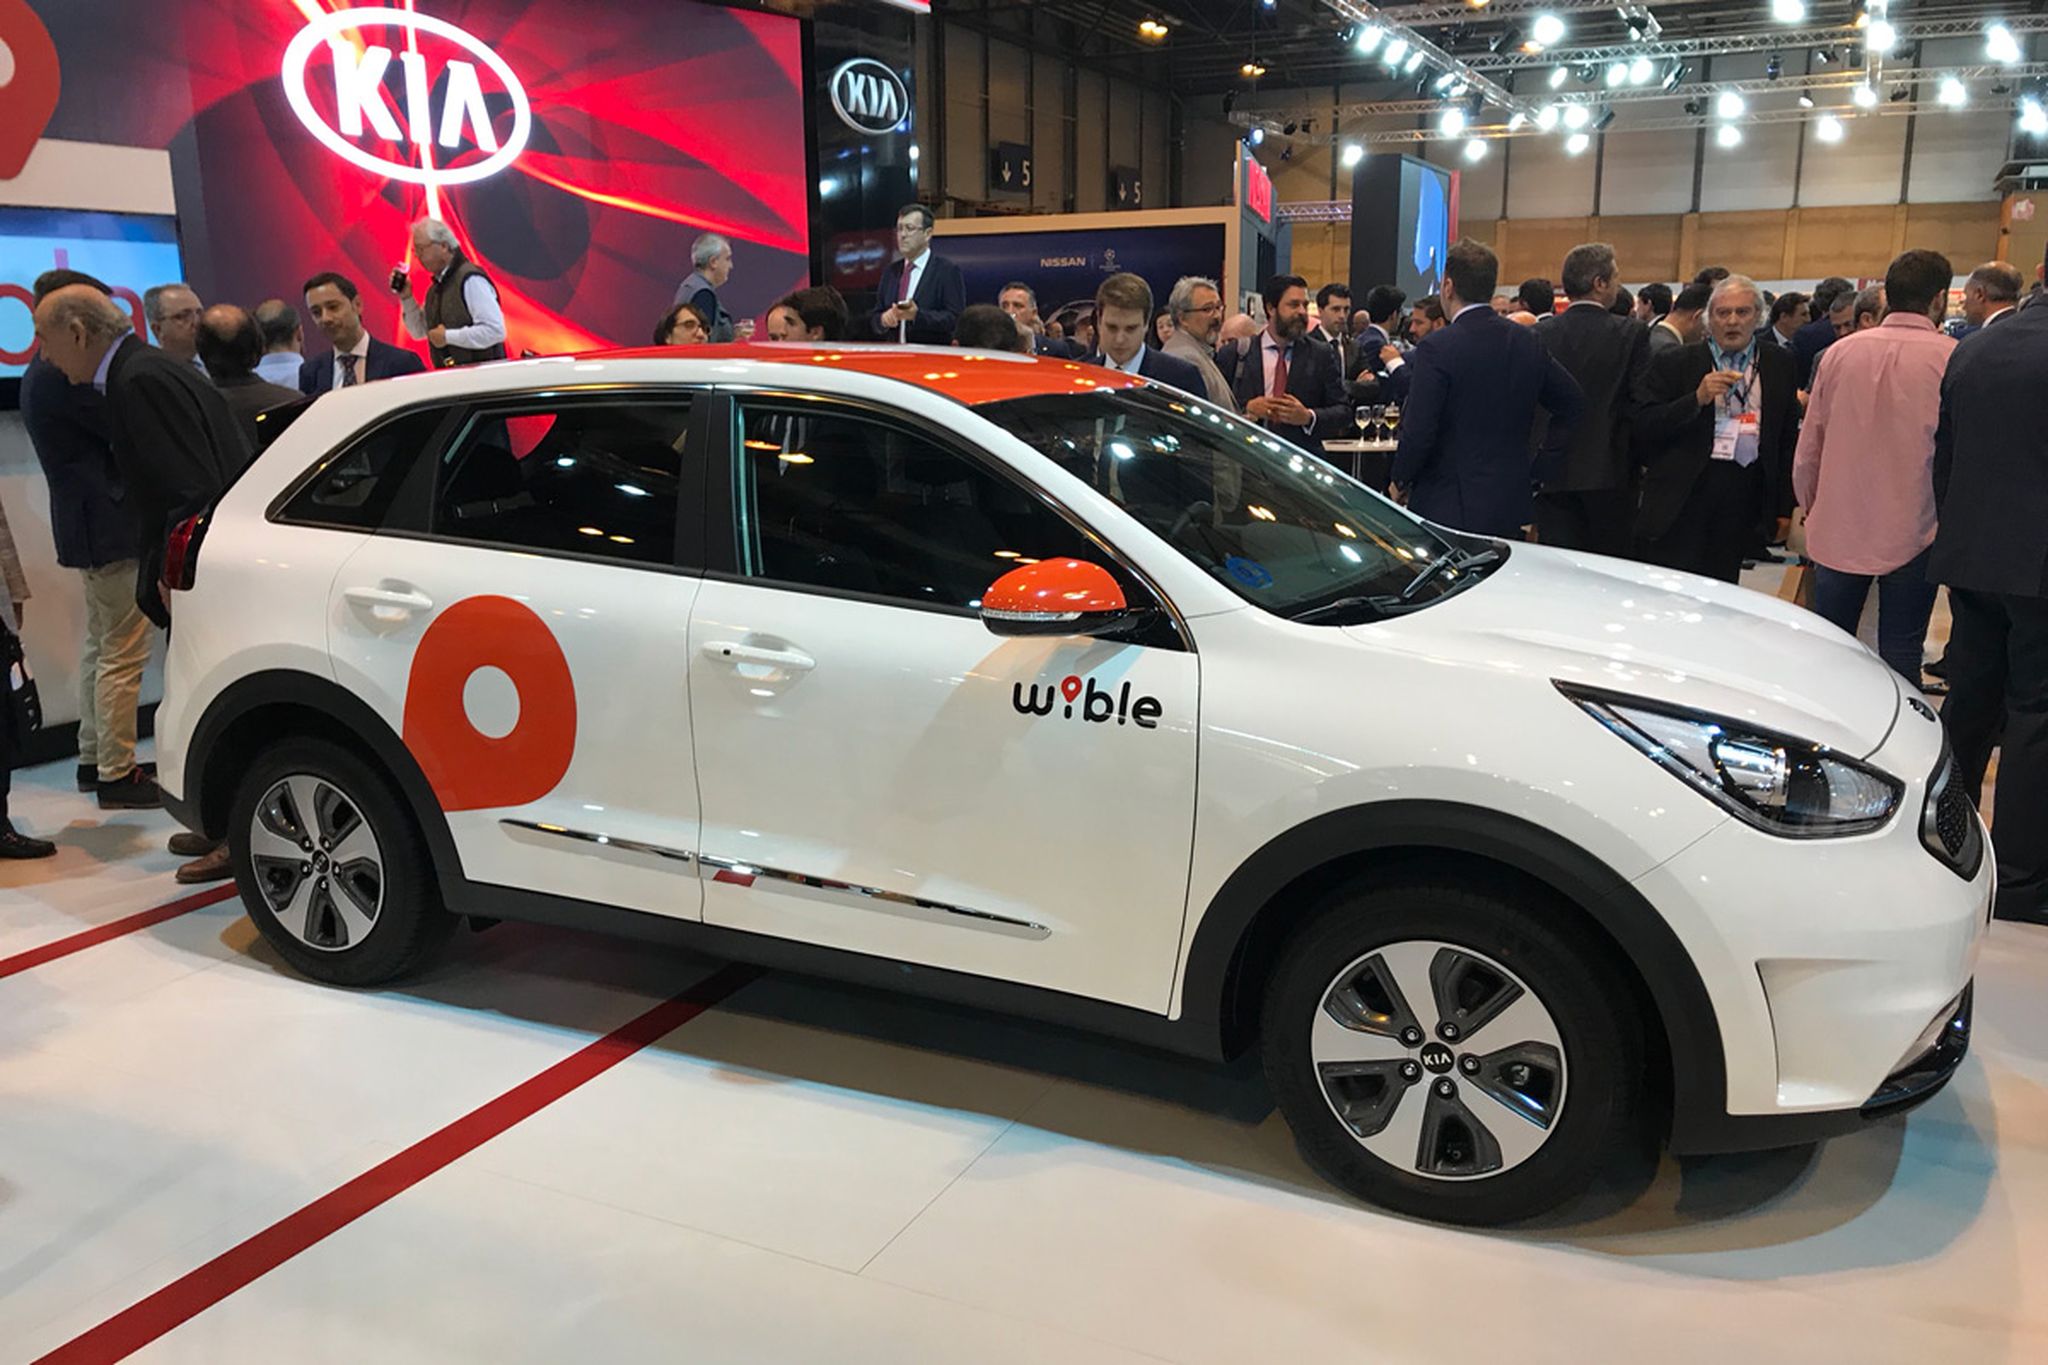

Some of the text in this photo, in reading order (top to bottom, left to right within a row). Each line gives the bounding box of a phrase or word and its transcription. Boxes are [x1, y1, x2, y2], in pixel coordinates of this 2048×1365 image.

[327, 38, 499, 153] KIA
[846, 70, 898, 121] KIA
[1022, 160, 1031, 187] 5
[1133, 181, 1141, 204] 5
[1040, 256, 1086, 268] NISSAN
[1013, 675, 1162, 729] wible
[1422, 1053, 1452, 1066] KIA
